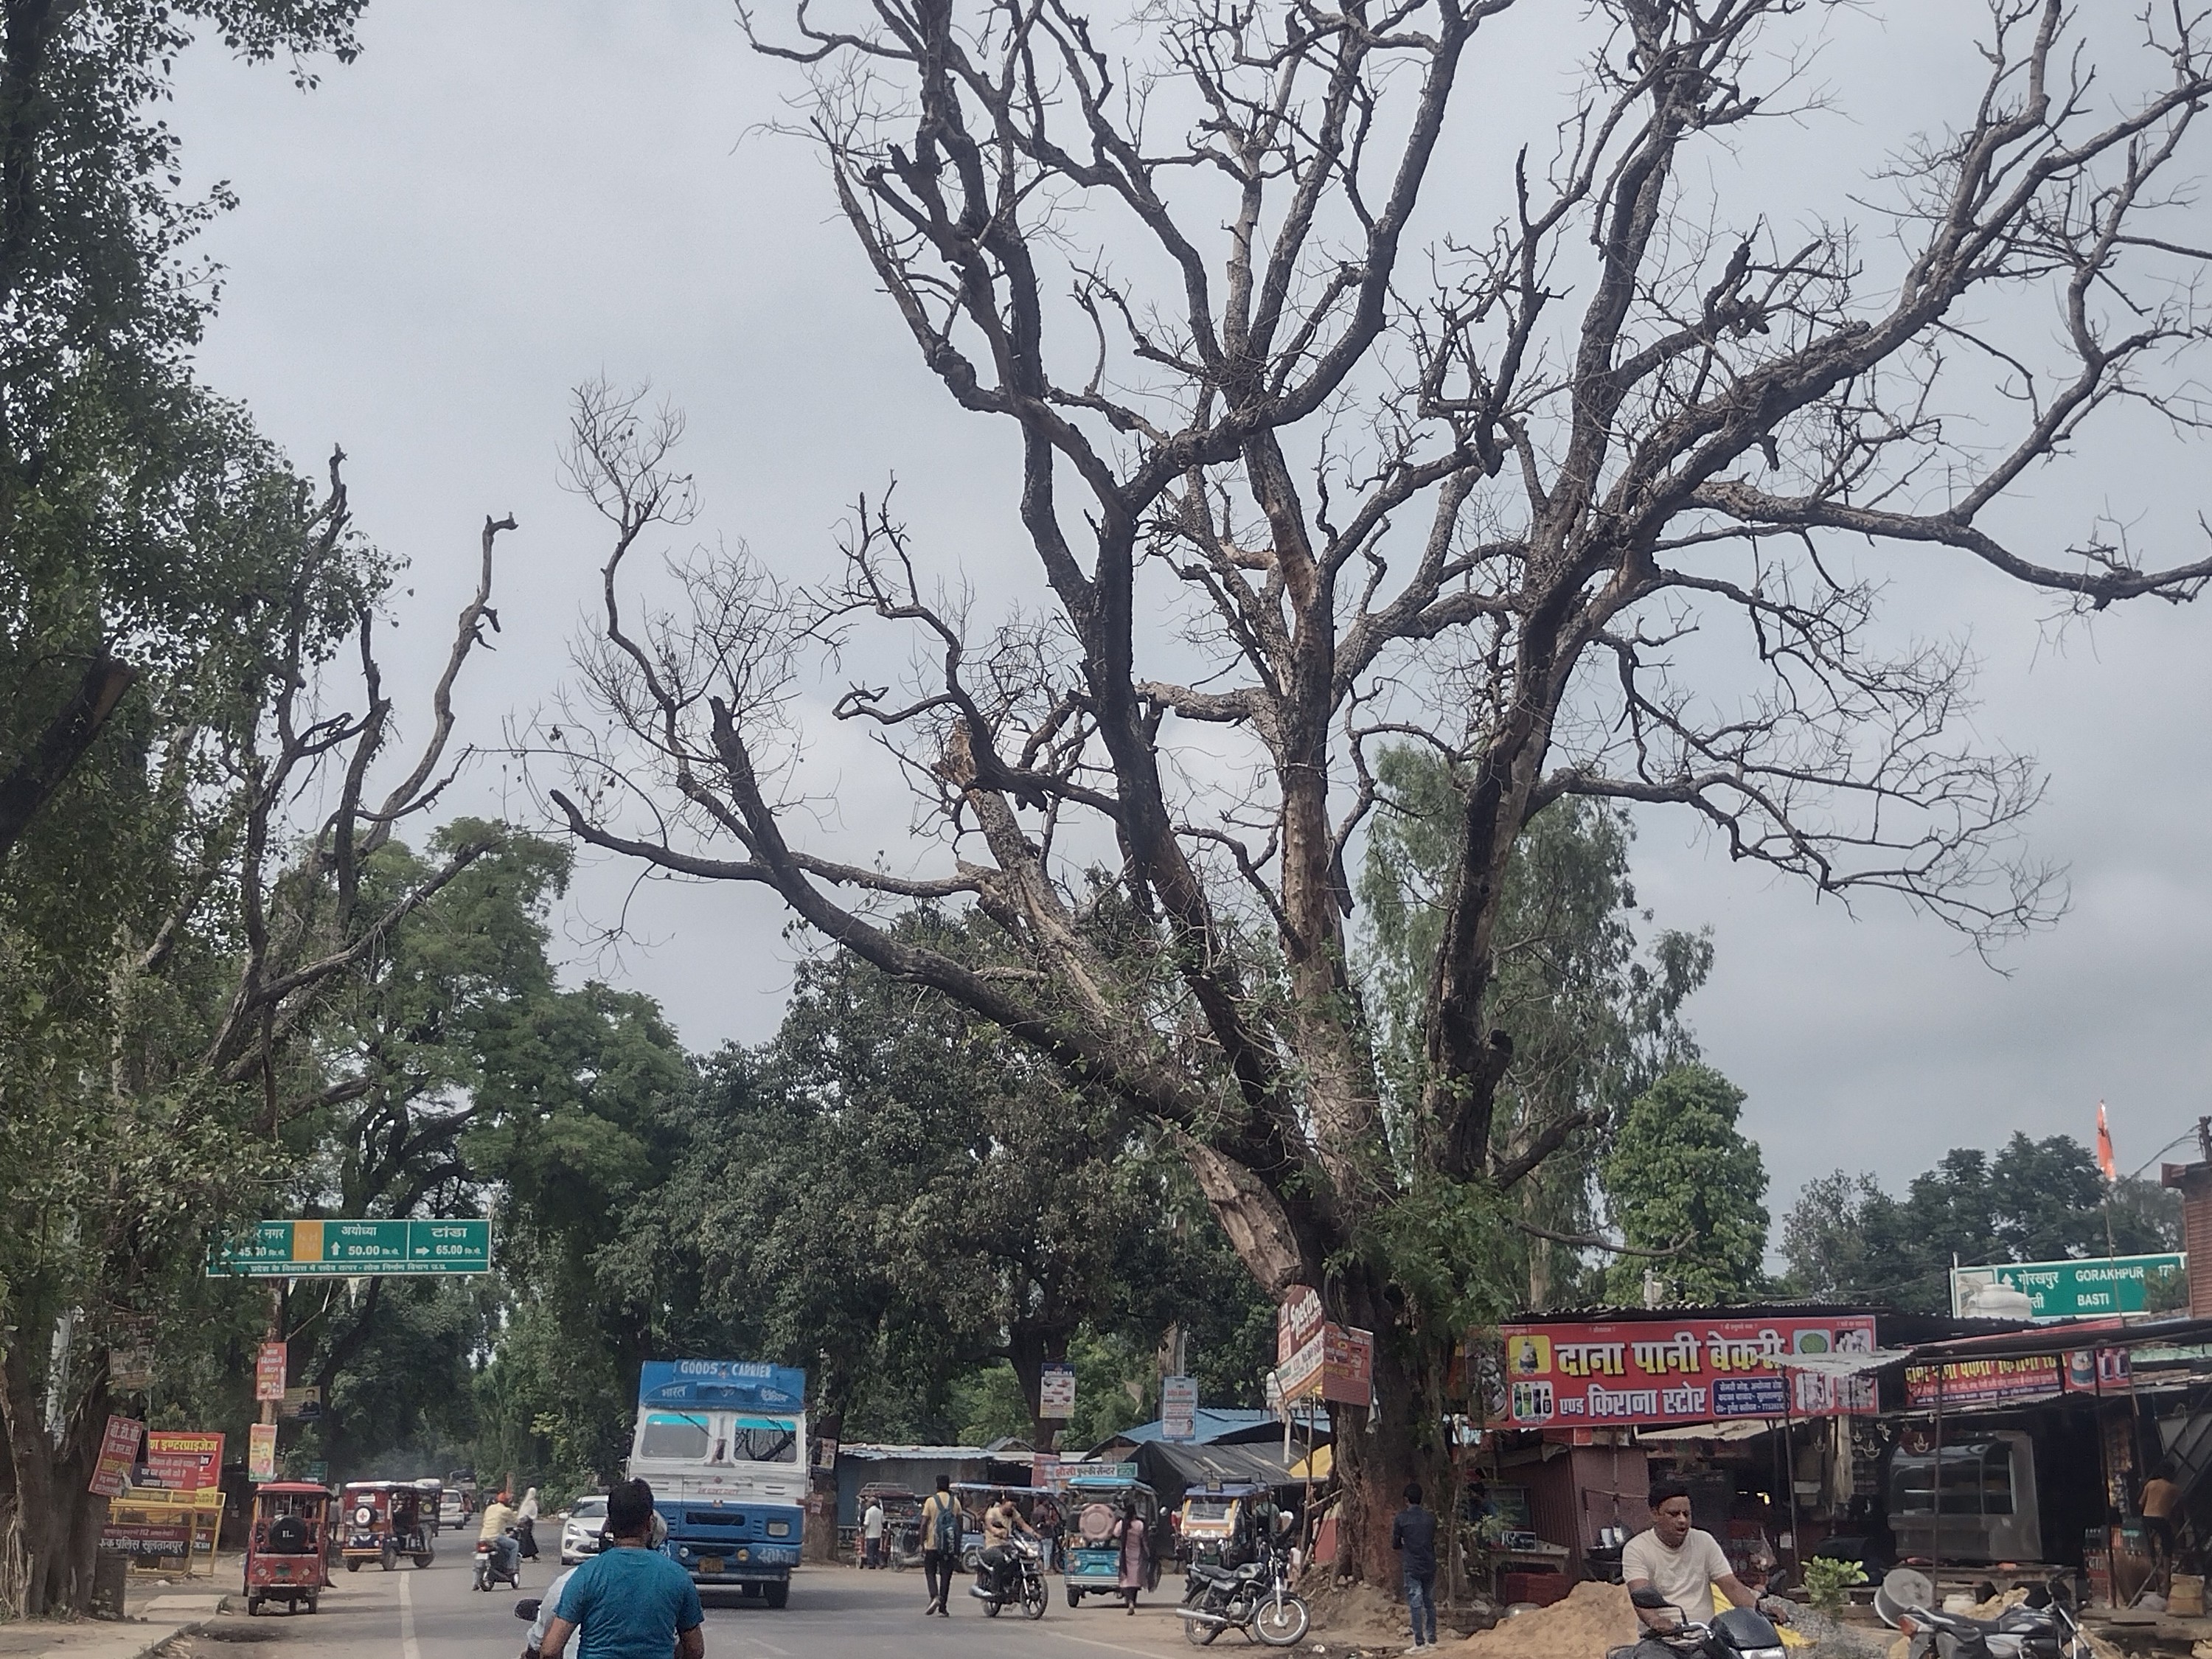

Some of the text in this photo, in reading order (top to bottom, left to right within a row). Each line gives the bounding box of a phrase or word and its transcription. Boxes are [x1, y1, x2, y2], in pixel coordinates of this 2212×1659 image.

[265, 1228, 285, 1239] नगर
[341, 1223, 378, 1237] अयोध्या
[431, 1225, 467, 1238] टांडा
[348, 1245, 380, 1256] 50.00
[436, 1245, 463, 1255] 65.00
[2017, 1270, 2059, 1290] गोरखपुर
[2075, 1265, 2144, 1282] GORAKHPUR
[2077, 1293, 2110, 1307] BASTI
[1554, 1329, 1786, 1376] दाना पानी बेकरी
[681, 1360, 772, 1378] GOODS CARRIER
[661, 1385, 687, 1398] भारत
[1559, 1380, 1706, 1416] एण्ड किराना स्टोर
[161, 1438, 218, 1452] इण्टरप्राइजेज
[142, 1539, 184, 1554] सुलतानपुर
